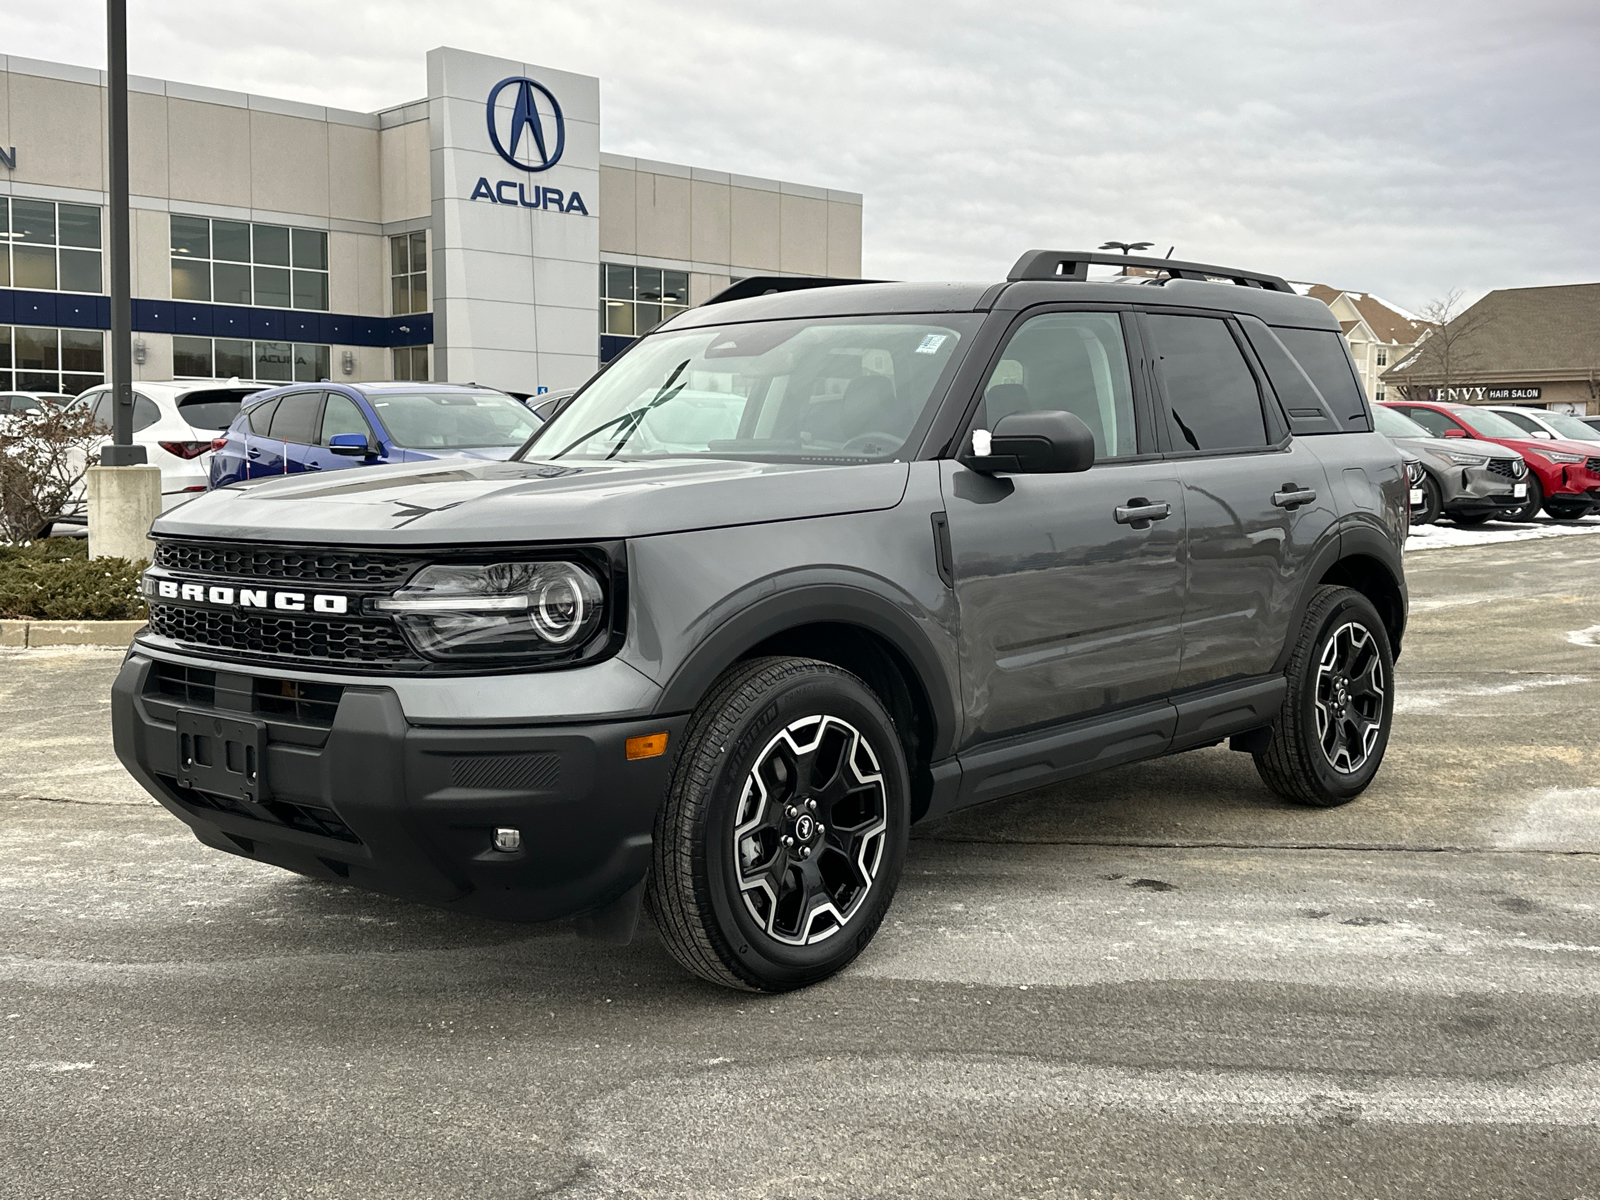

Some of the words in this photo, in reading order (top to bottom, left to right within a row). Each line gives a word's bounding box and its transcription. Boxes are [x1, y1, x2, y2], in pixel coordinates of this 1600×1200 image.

[470, 177, 588, 216] ACURA
[1436, 387, 1487, 401] ENVY
[1489, 389, 1509, 398] HAIR
[1511, 389, 1538, 398] SALON
[158, 580, 348, 614] BRONCO
[728, 704, 778, 780] MICHELIN
